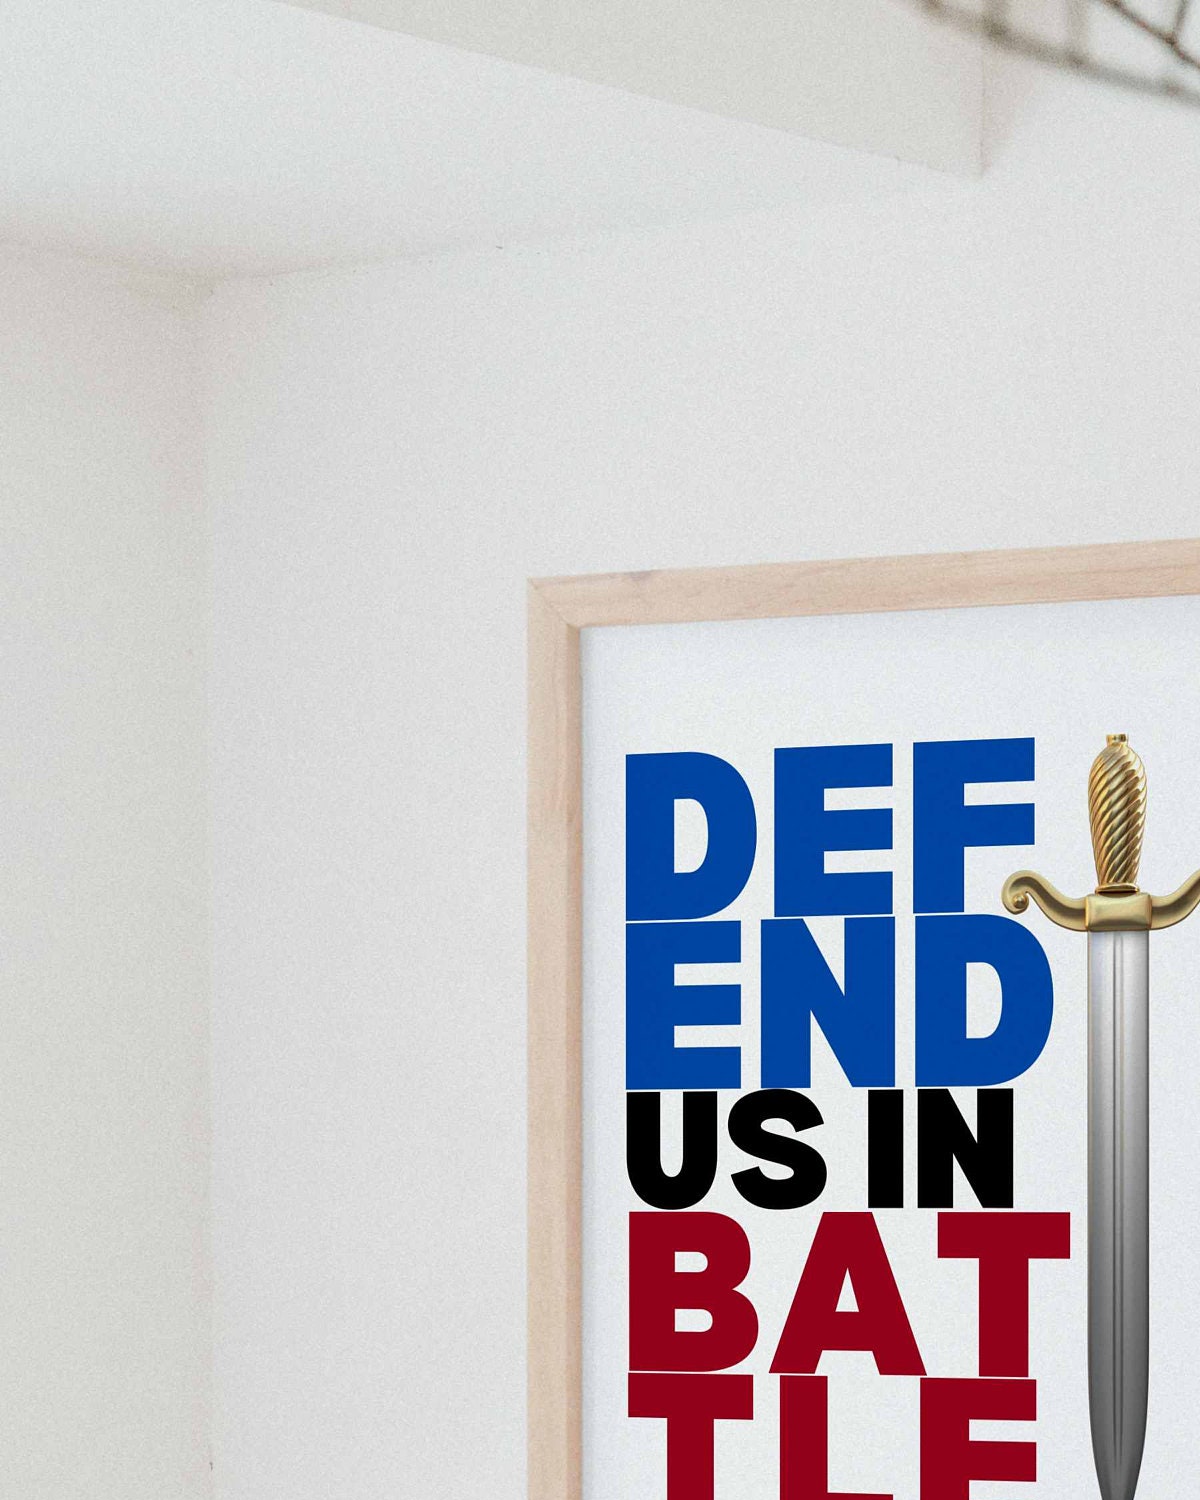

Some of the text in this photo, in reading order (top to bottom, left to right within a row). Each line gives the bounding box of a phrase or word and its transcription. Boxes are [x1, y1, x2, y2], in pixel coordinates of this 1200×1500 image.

[626, 738, 1035, 921] DEF
[626, 914, 1054, 1090] END
[627, 1089, 1013, 1210] US IN
[629, 1212, 1070, 1378] BAT
